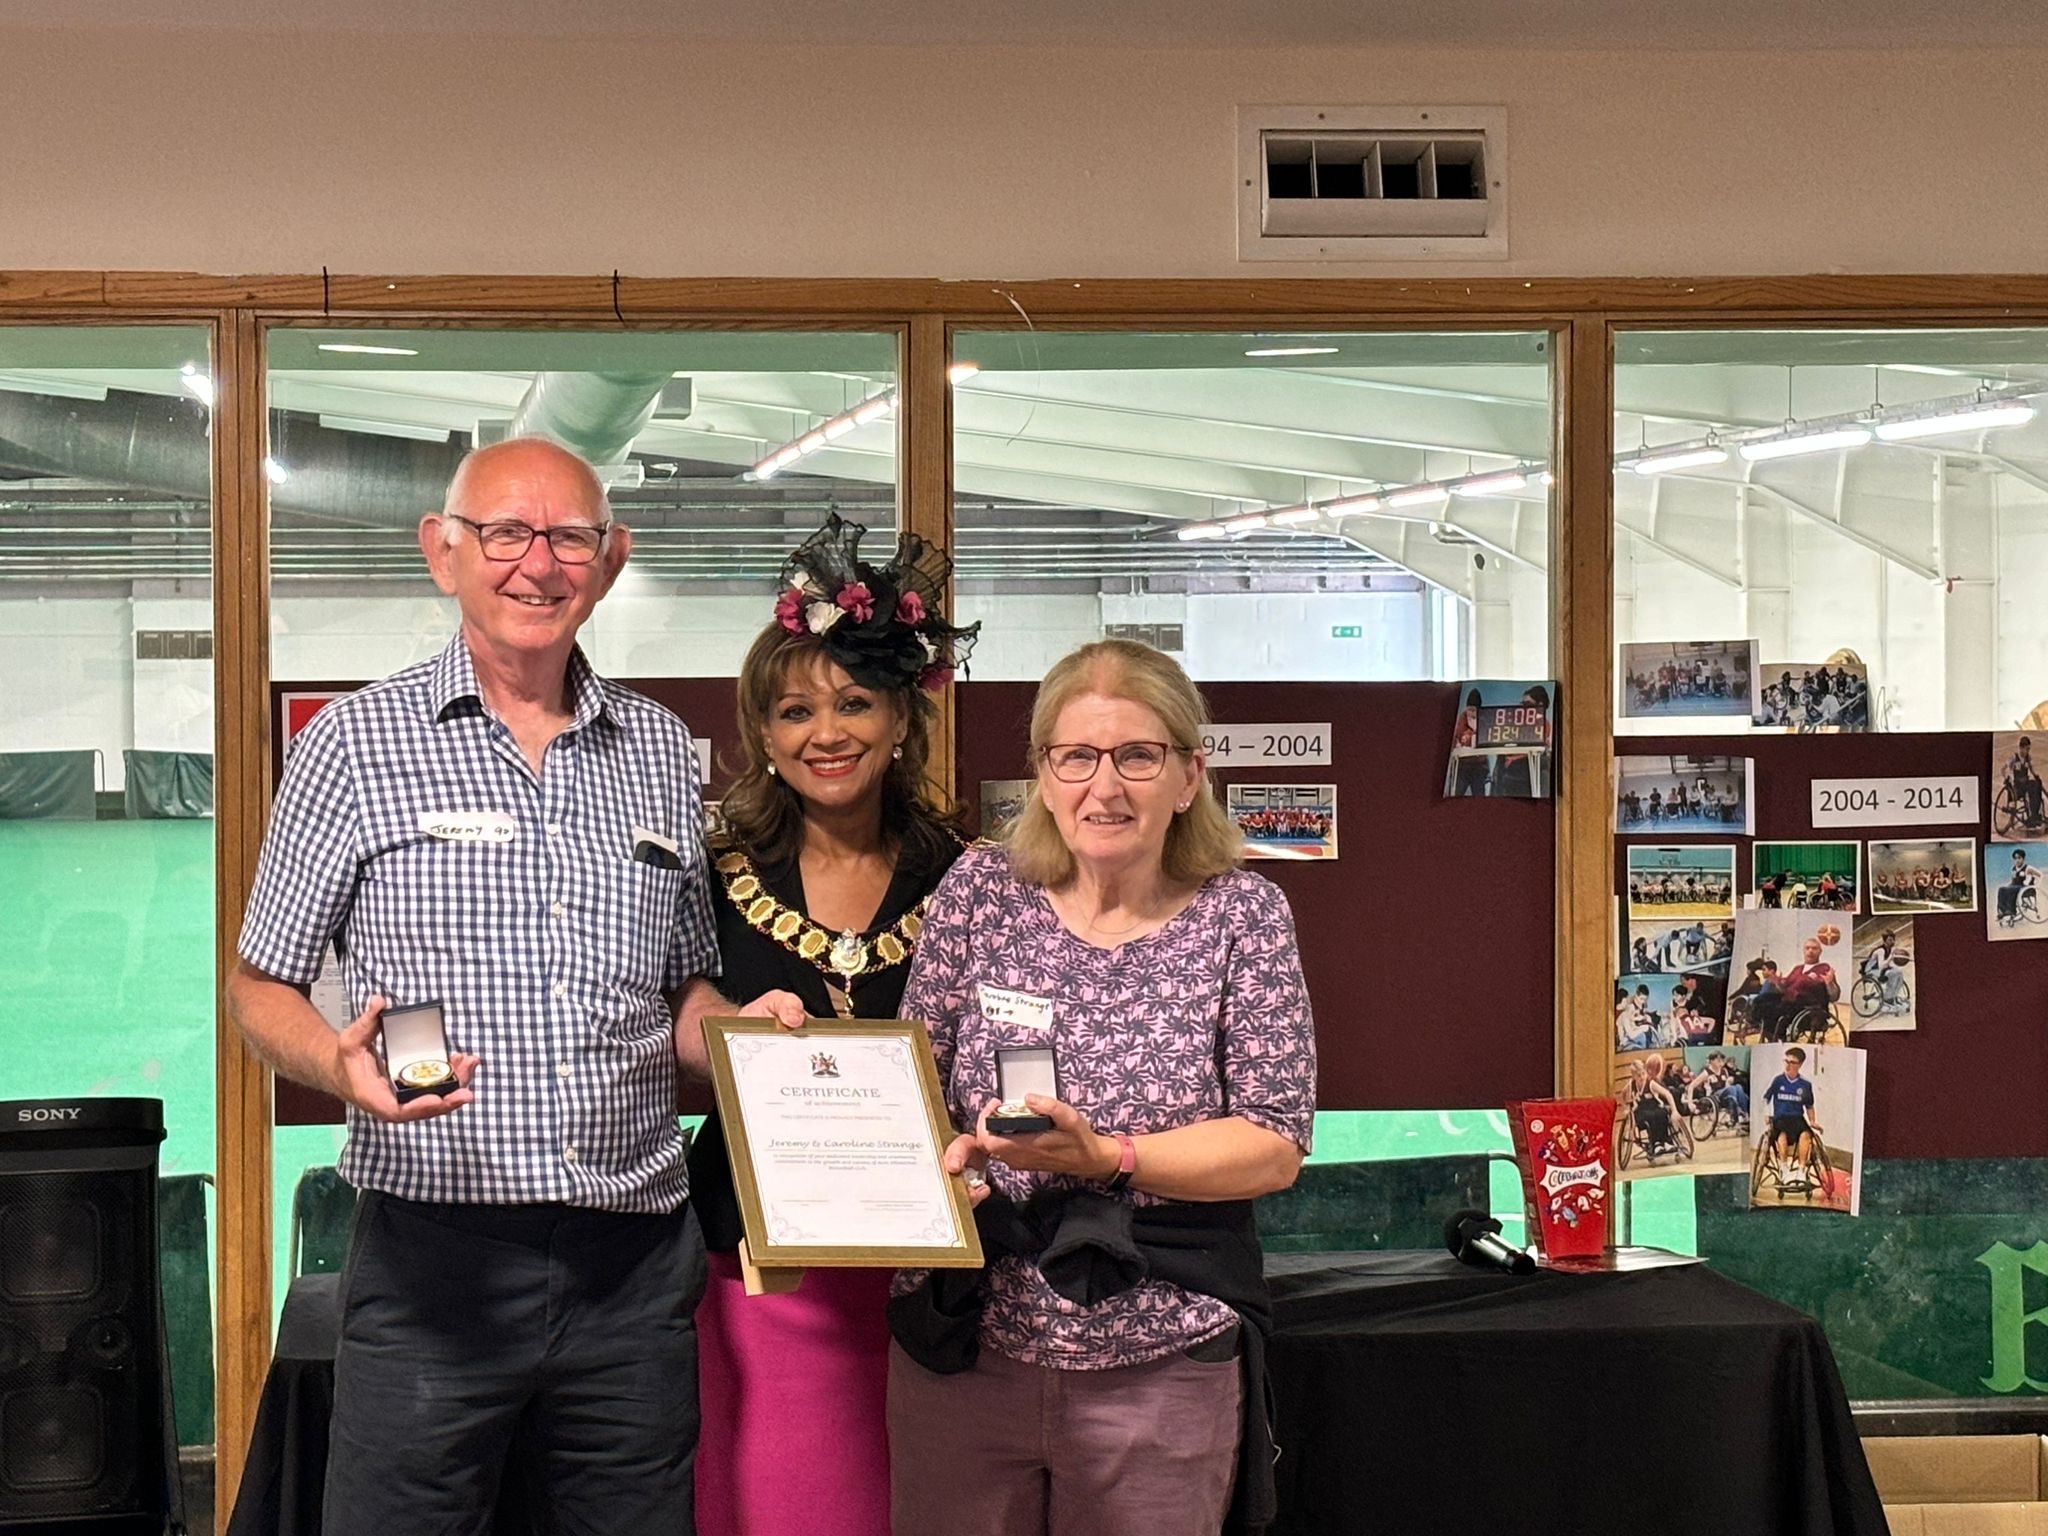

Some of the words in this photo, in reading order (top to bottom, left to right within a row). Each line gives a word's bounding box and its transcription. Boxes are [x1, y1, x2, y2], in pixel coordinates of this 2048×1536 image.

[1495, 708, 1537, 726] 8:08
[1534, 726, 1544, 740] 4
[1202, 735, 1232, 757] 94
[1262, 735, 1323, 757] 2004
[1819, 789, 1879, 812] 2004
[1903, 786, 1964, 809] 2014
[780, 1086, 881, 1098] CERTIFICATE
[18, 1108, 82, 1122] SONY
[768, 1139, 810, 1150] Jeremy
[824, 1139, 876, 1149] Caroline
[877, 1141, 925, 1151] Strange
